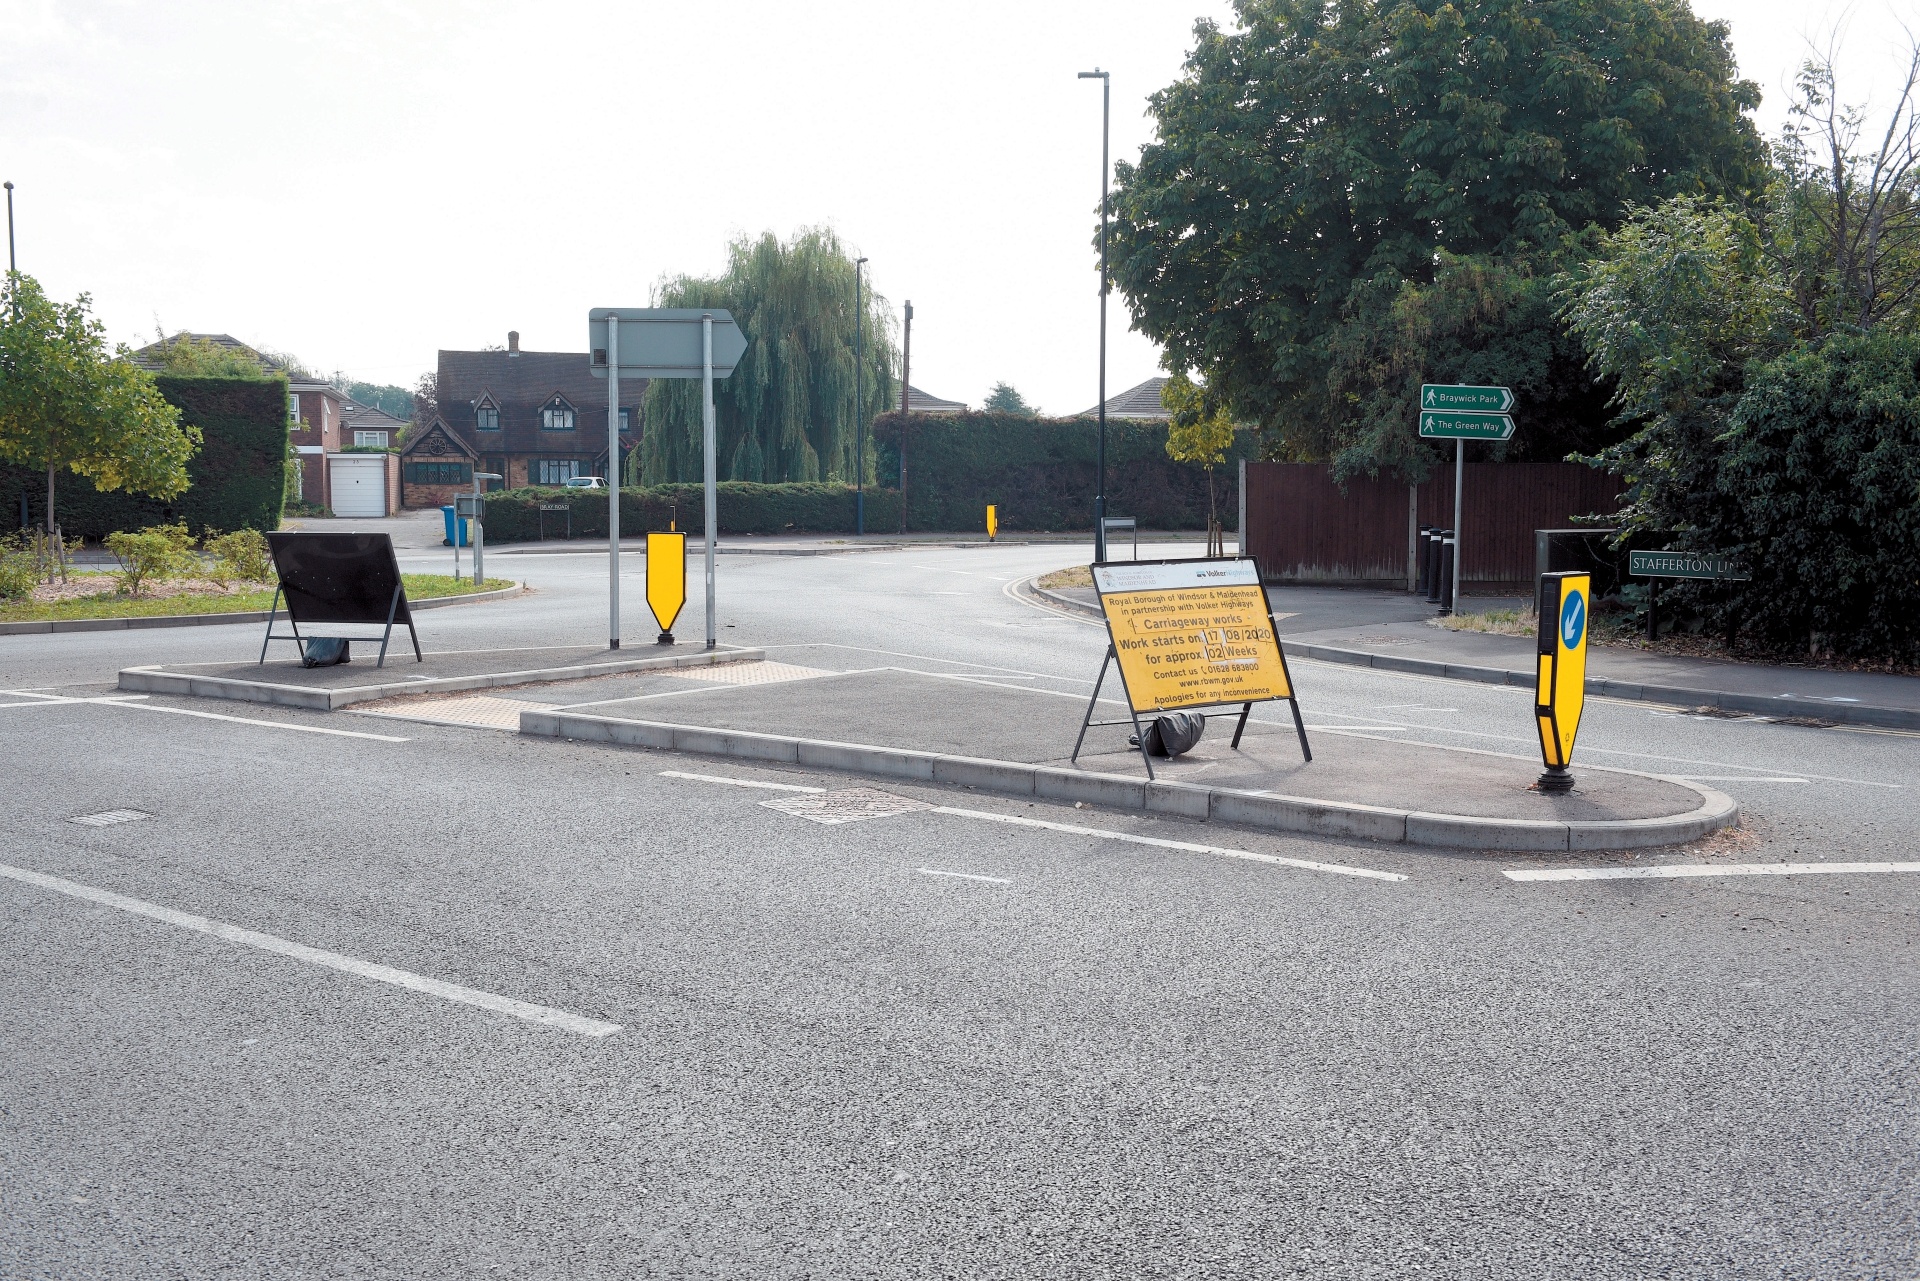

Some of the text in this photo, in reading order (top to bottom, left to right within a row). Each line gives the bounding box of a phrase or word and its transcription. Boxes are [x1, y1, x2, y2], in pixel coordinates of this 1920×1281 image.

[1440, 393, 1498, 403] Braywick Park
[1438, 420, 1500, 432] The Green Way
[1633, 557, 1712, 572] STAFFERTON
[1109, 590, 1258, 607] Royal Borough of Windsor & Maidenhead
[1121, 599, 1254, 617] in partnership with Volker Highways
[1143, 614, 1243, 630] Carriageway works
[1118, 637, 1149, 650] Work
[1152, 633, 1185, 647] starts
[1208, 630, 1218, 641] 17
[1145, 645, 1258, 665] for approx. 02 Weeks
[1153, 669, 1187, 680] Contact
[1207, 665, 1230, 674] 01628
[1231, 663, 1260, 673] 683800
[1179, 675, 1244, 689] www.rbwm.gov.uk
[1154, 686, 1271, 705] Apologies for any inconvenience
